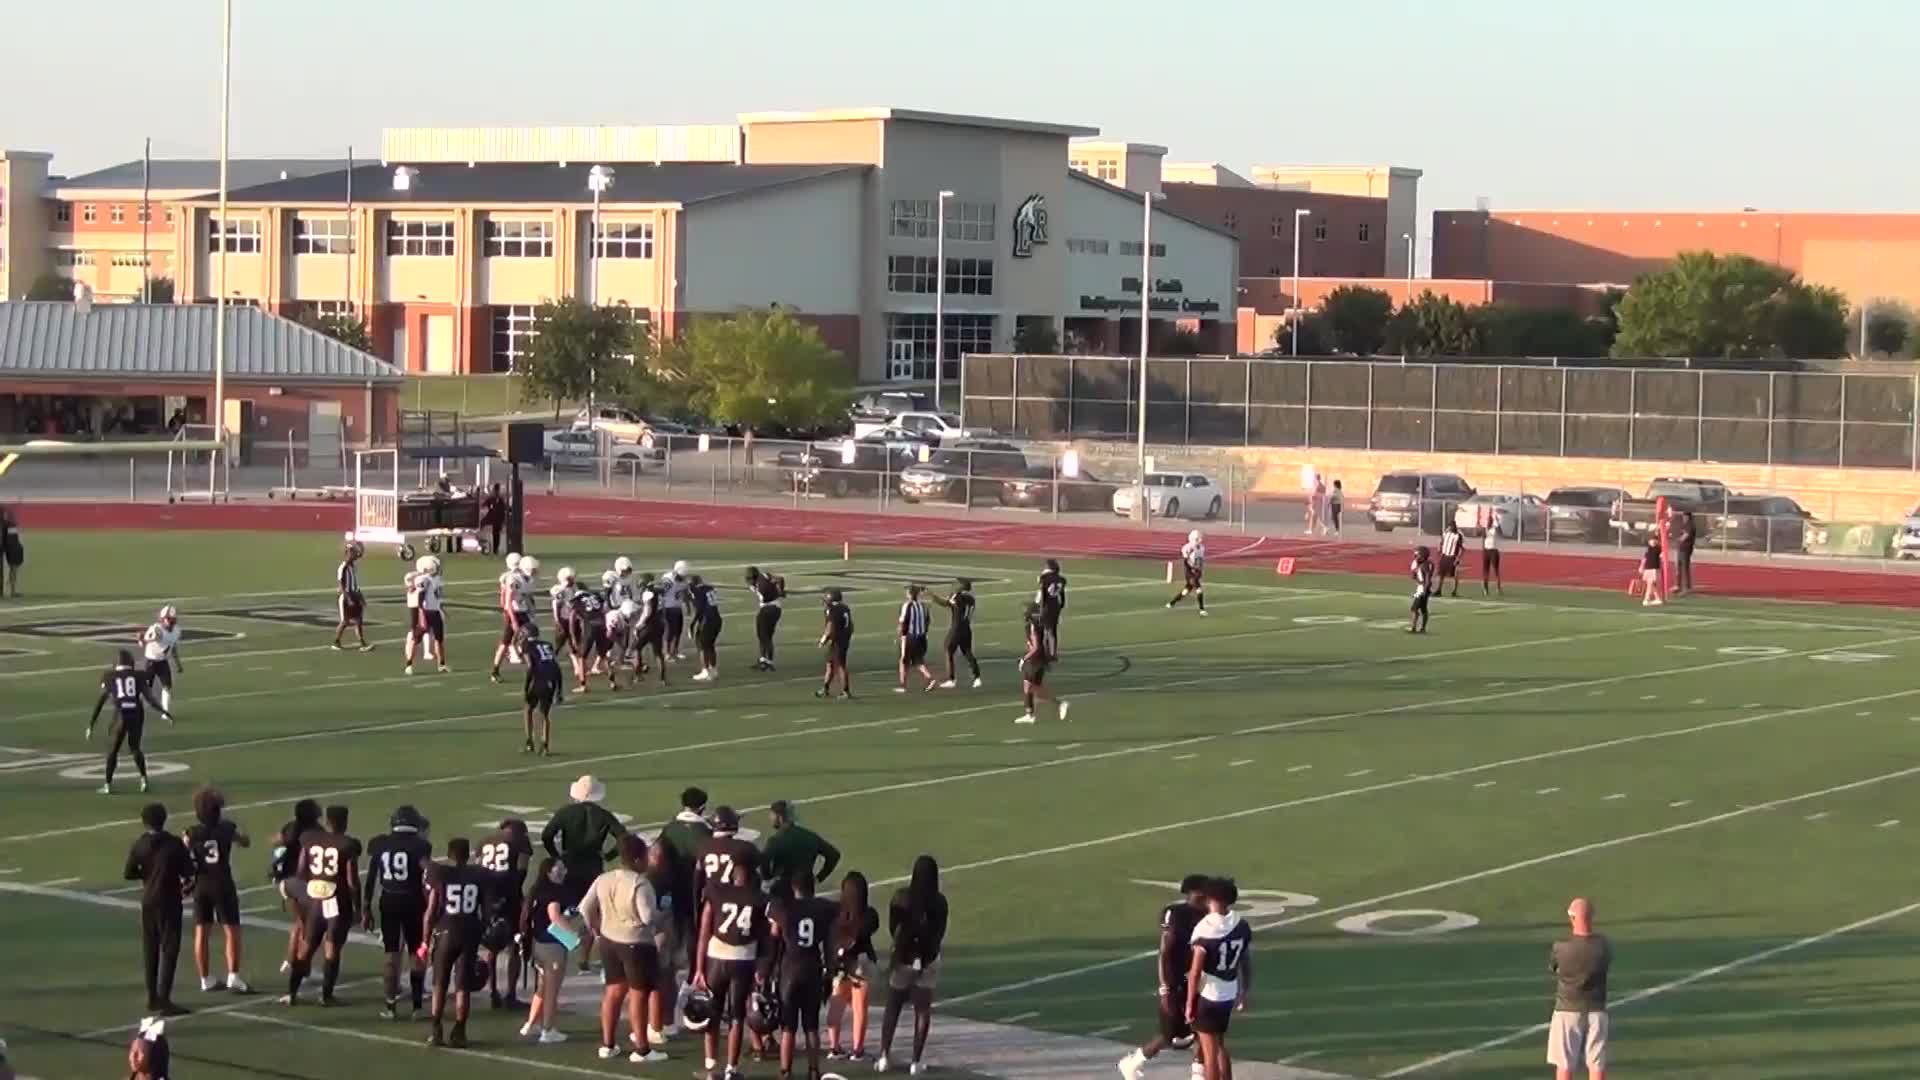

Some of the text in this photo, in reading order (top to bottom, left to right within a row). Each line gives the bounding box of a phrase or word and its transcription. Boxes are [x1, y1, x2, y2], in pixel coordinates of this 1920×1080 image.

[115, 676, 136, 698] 18
[204, 840, 219, 865] 3
[309, 845, 339, 876] 33
[380, 851, 409, 882] 19
[482, 843, 509, 871] 22
[704, 853, 734, 883] 27
[445, 884, 478, 914] 58
[718, 902, 753, 936] 74
[798, 918, 814, 948] 9
[1216, 939, 1243, 971] 17
